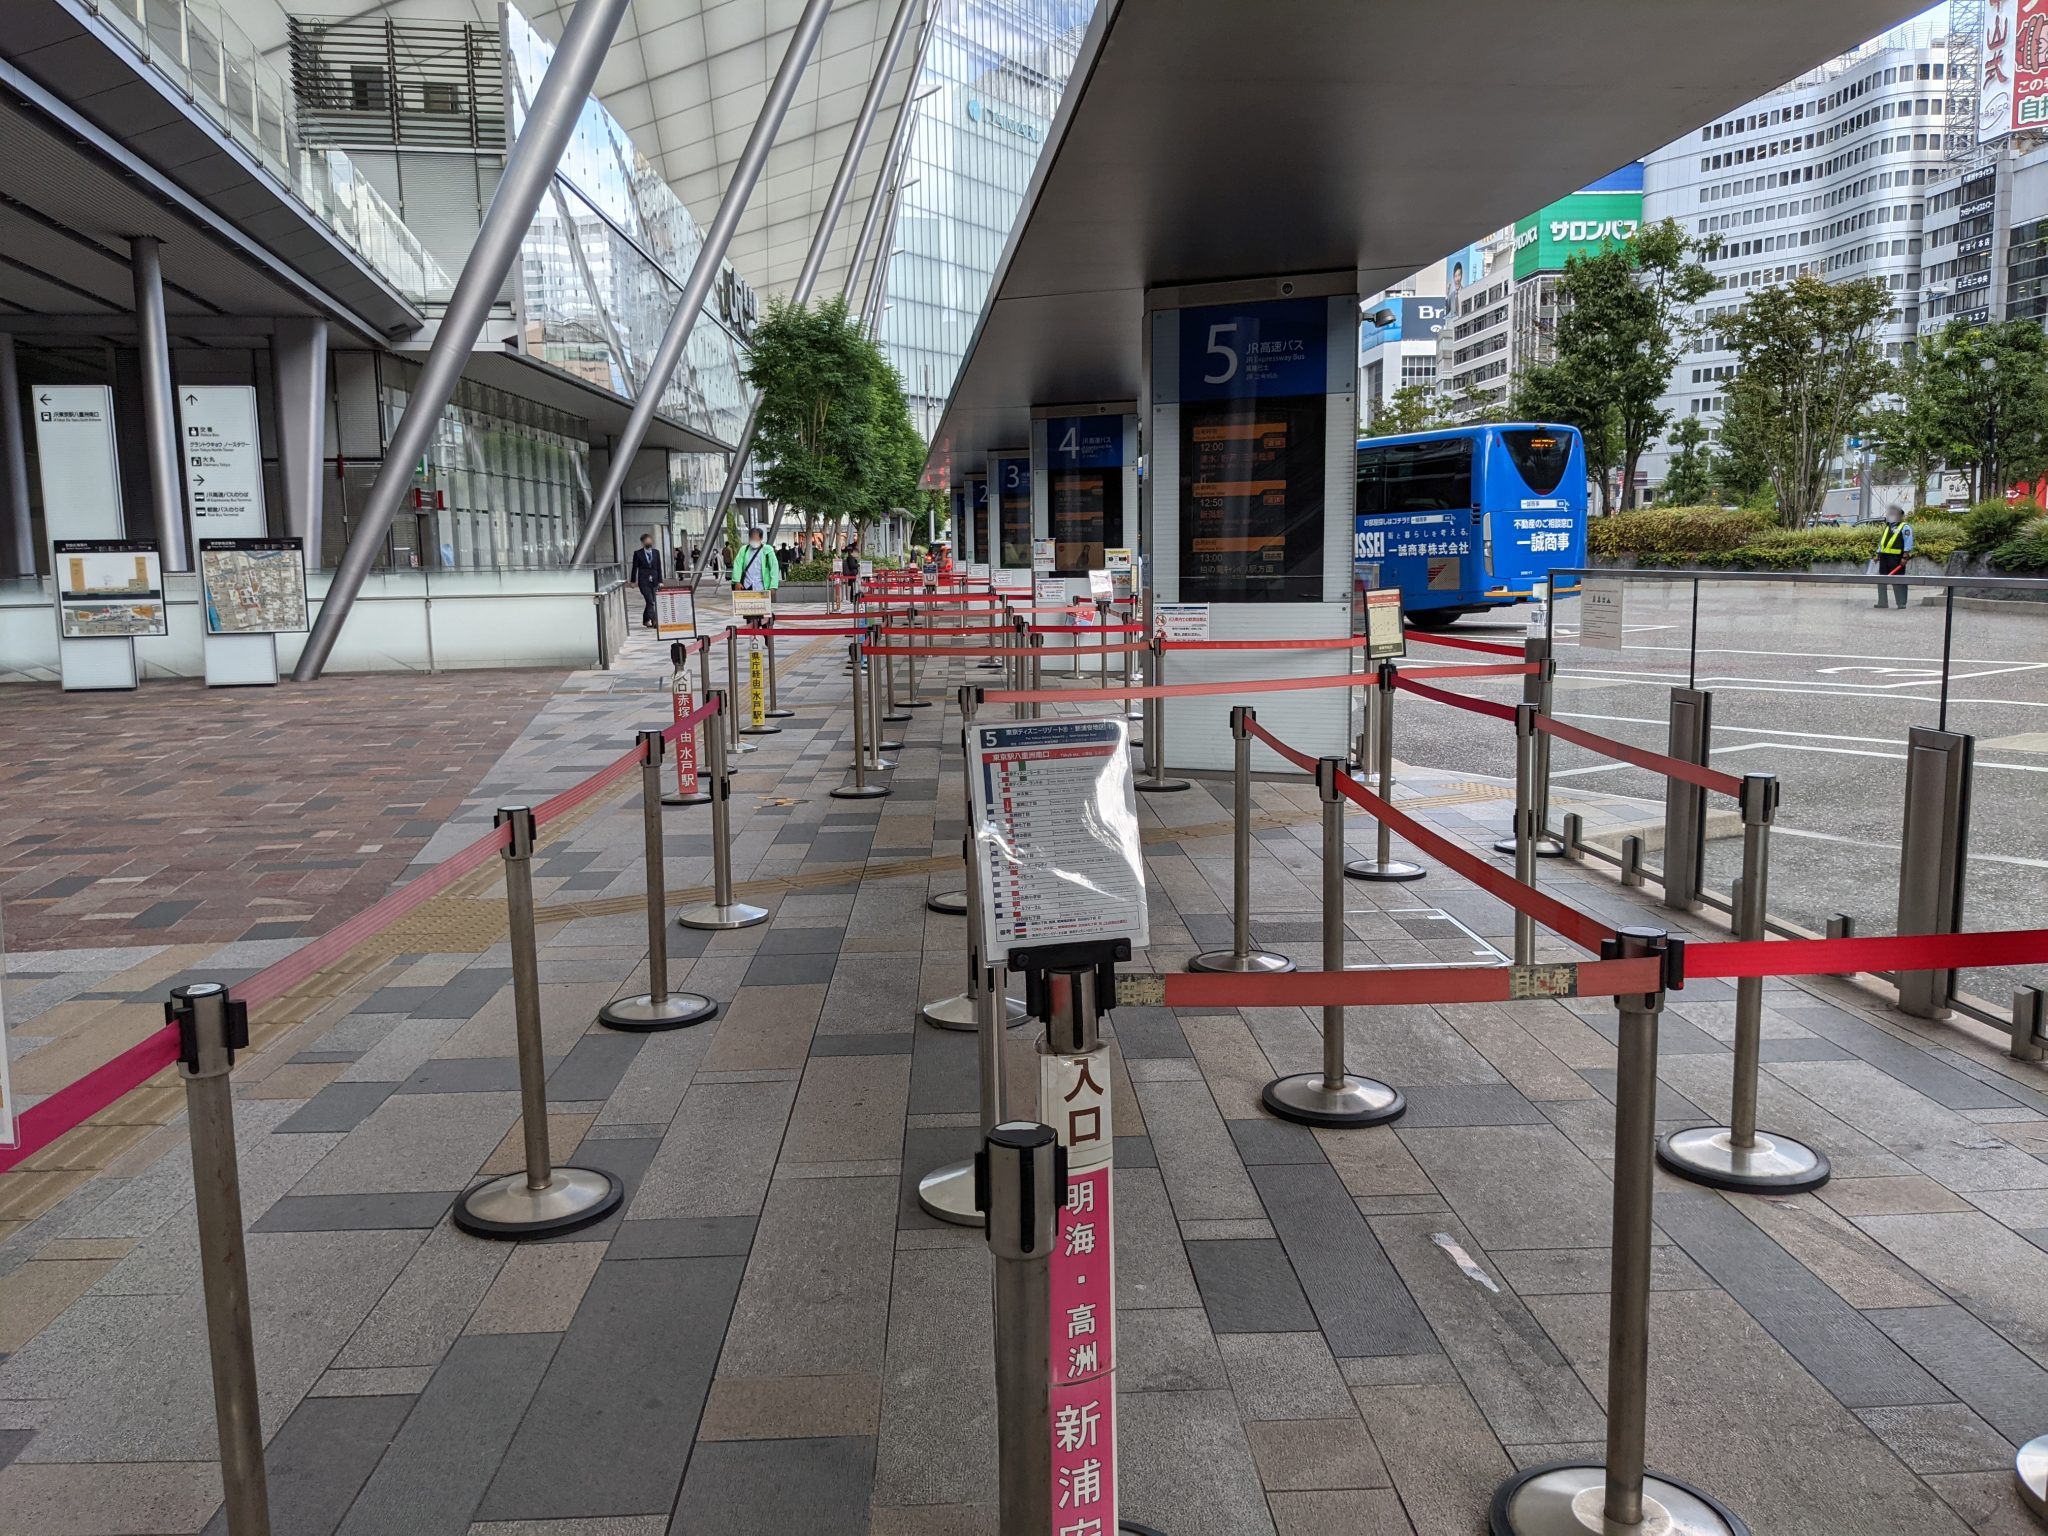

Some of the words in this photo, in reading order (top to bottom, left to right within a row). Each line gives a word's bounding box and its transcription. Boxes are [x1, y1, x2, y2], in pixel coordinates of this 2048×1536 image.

[1982, 0, 2008, 90] 山式
[1550, 220, 1639, 242] サロンパス
[1204, 323, 1238, 384] 5
[1246, 340, 1304, 355] JR高速バス
[1058, 427, 1080, 459] 4
[1200, 442, 1223, 452] 12:00
[1007, 465, 1020, 488] 3
[979, 485, 988, 503] 2
[1200, 498, 1223, 508] 12:50
[1513, 518, 1573, 530] 不動産のご相談窓口
[1388, 541, 1469, 557] 一誠商事株式会社
[1516, 531, 1570, 553] 一誠商事
[1200, 553, 1223, 562] 13:00
[678, 694, 692, 743] 赤塚由
[986, 731, 997, 746] 5
[680, 747, 695, 787] 水戸駅
[1065, 1058, 1104, 1146] 入口
[1065, 1182, 1098, 1380] 明海・高洲
